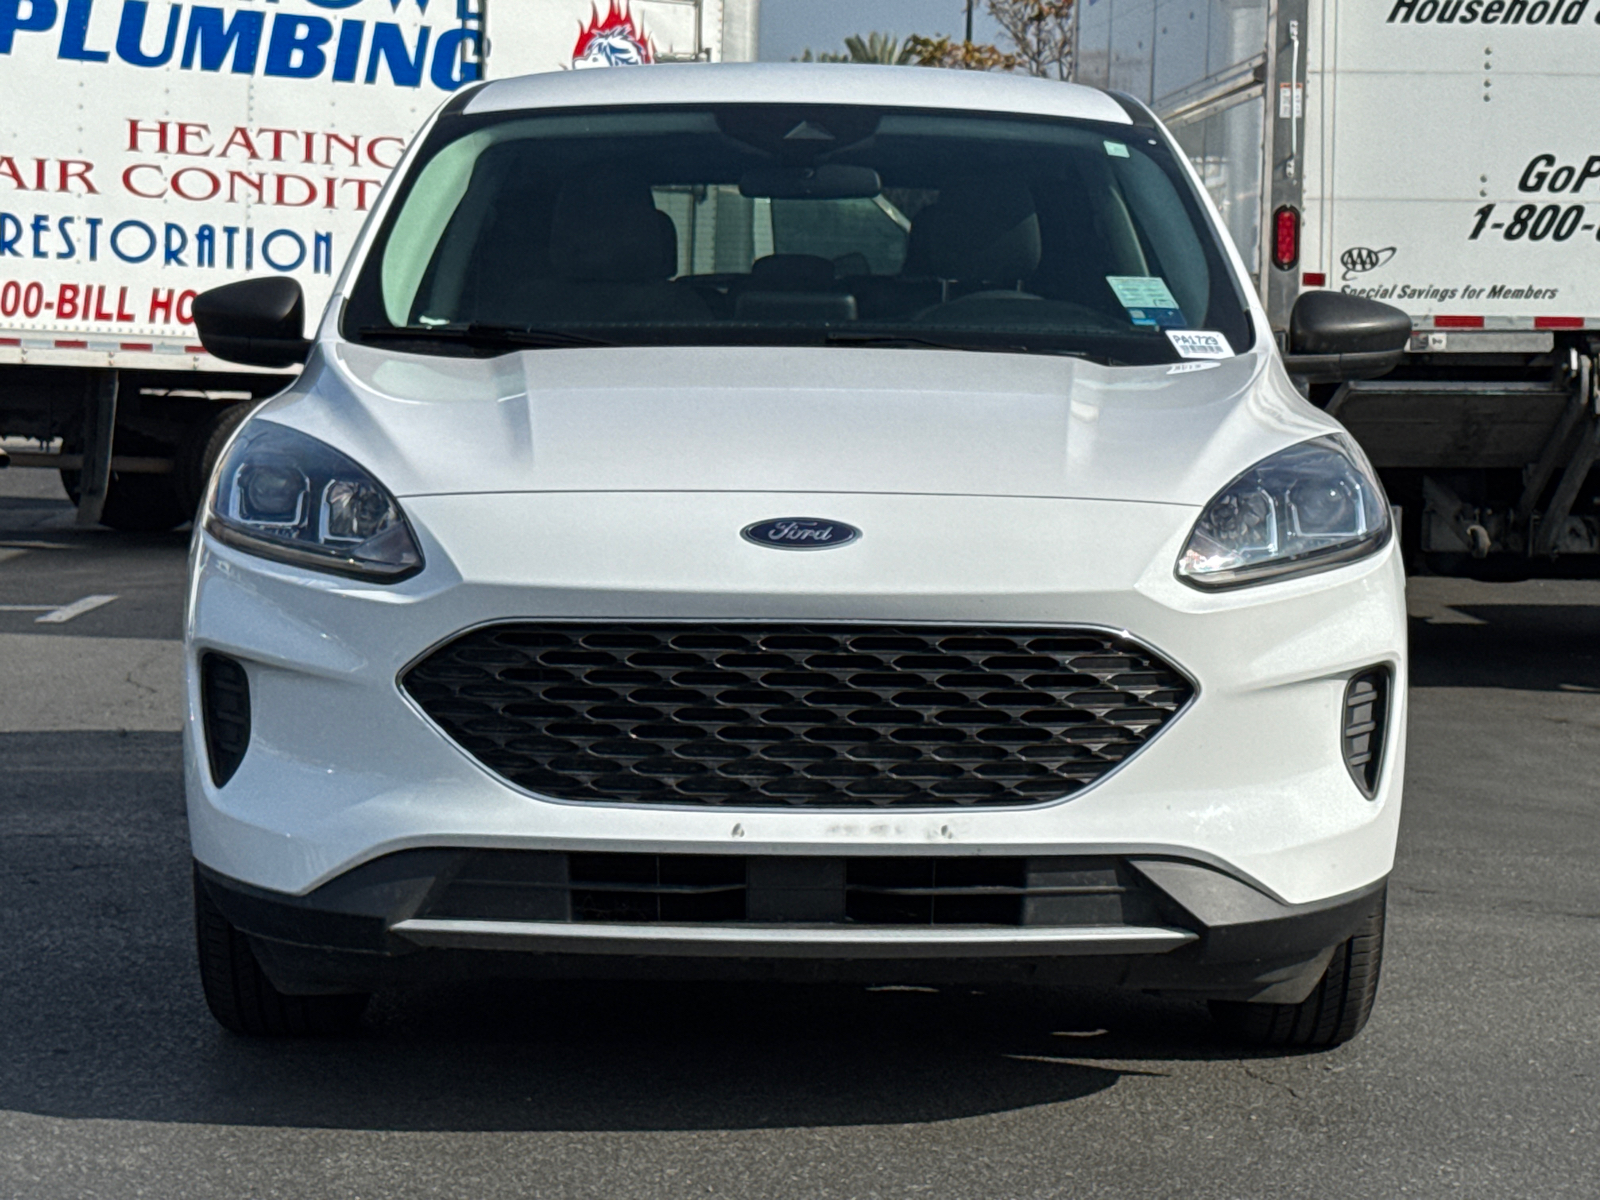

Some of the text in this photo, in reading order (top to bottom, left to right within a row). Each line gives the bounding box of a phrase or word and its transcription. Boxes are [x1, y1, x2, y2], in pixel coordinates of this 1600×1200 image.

[1386, 0, 1590, 25] Household
[0, 0, 487, 92] PLUMBING
[0, 155, 101, 195] AIR
[1468, 203, 1600, 242] 1-800-
[0, 212, 332, 275] RESTORATION
[1340, 284, 1559, 302] Special Savings for Members
[767, 521, 834, 541] Ford
